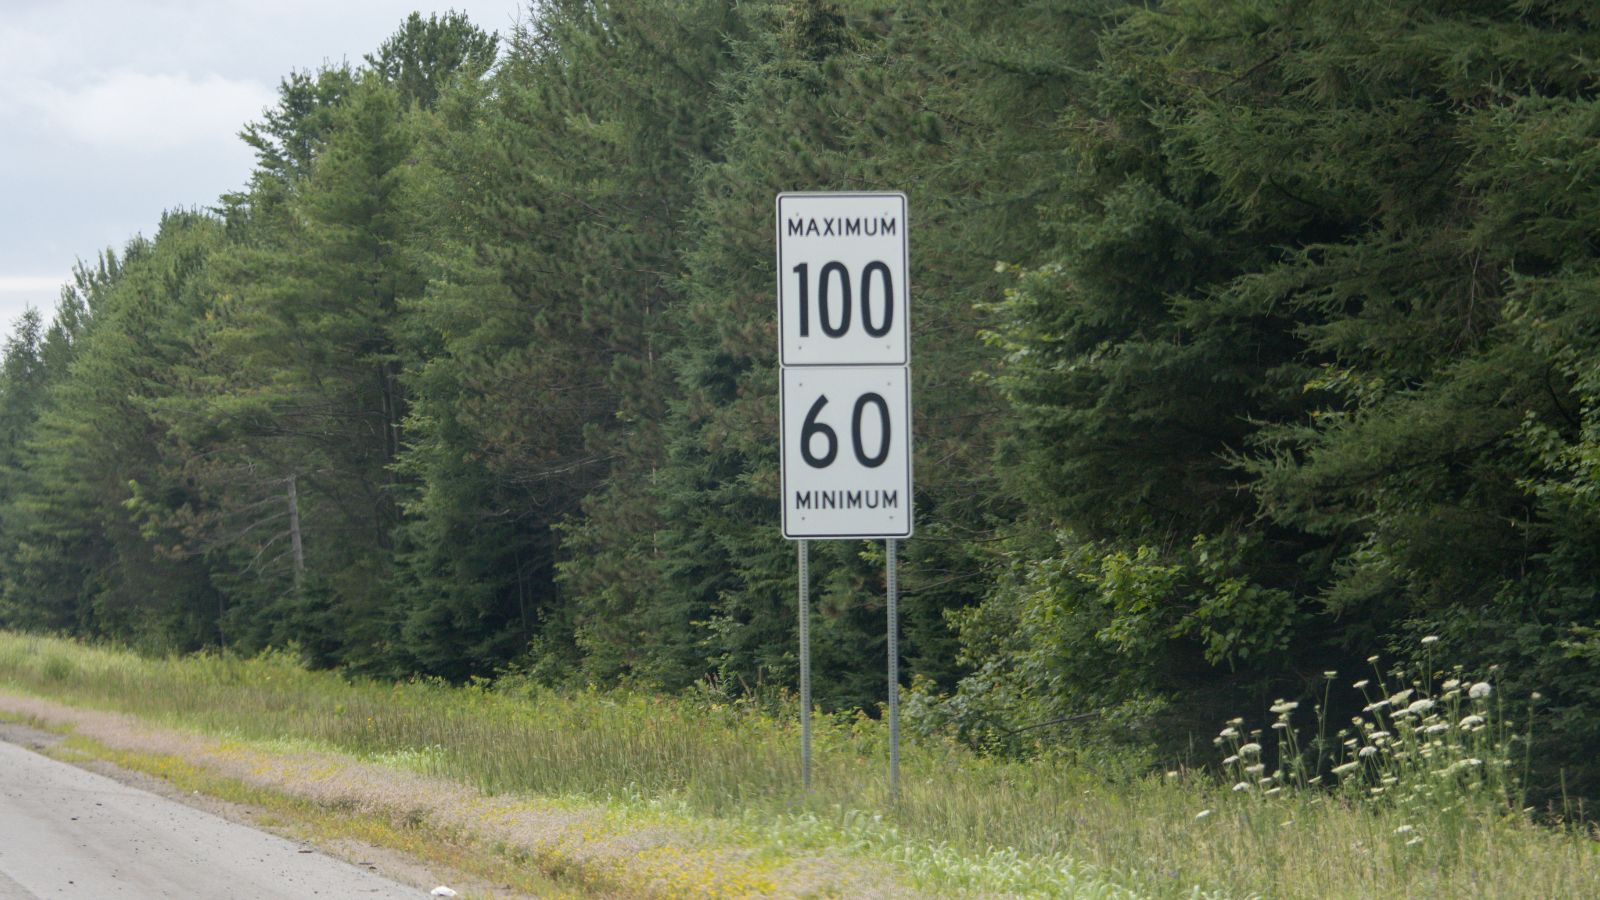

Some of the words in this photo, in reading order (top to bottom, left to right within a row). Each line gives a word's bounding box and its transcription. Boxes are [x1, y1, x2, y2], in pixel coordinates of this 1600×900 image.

[787, 217, 896, 237] MAXIMUM
[792, 260, 894, 339] 100
[799, 391, 892, 469] 60
[795, 489, 898, 510] MINIMUM
